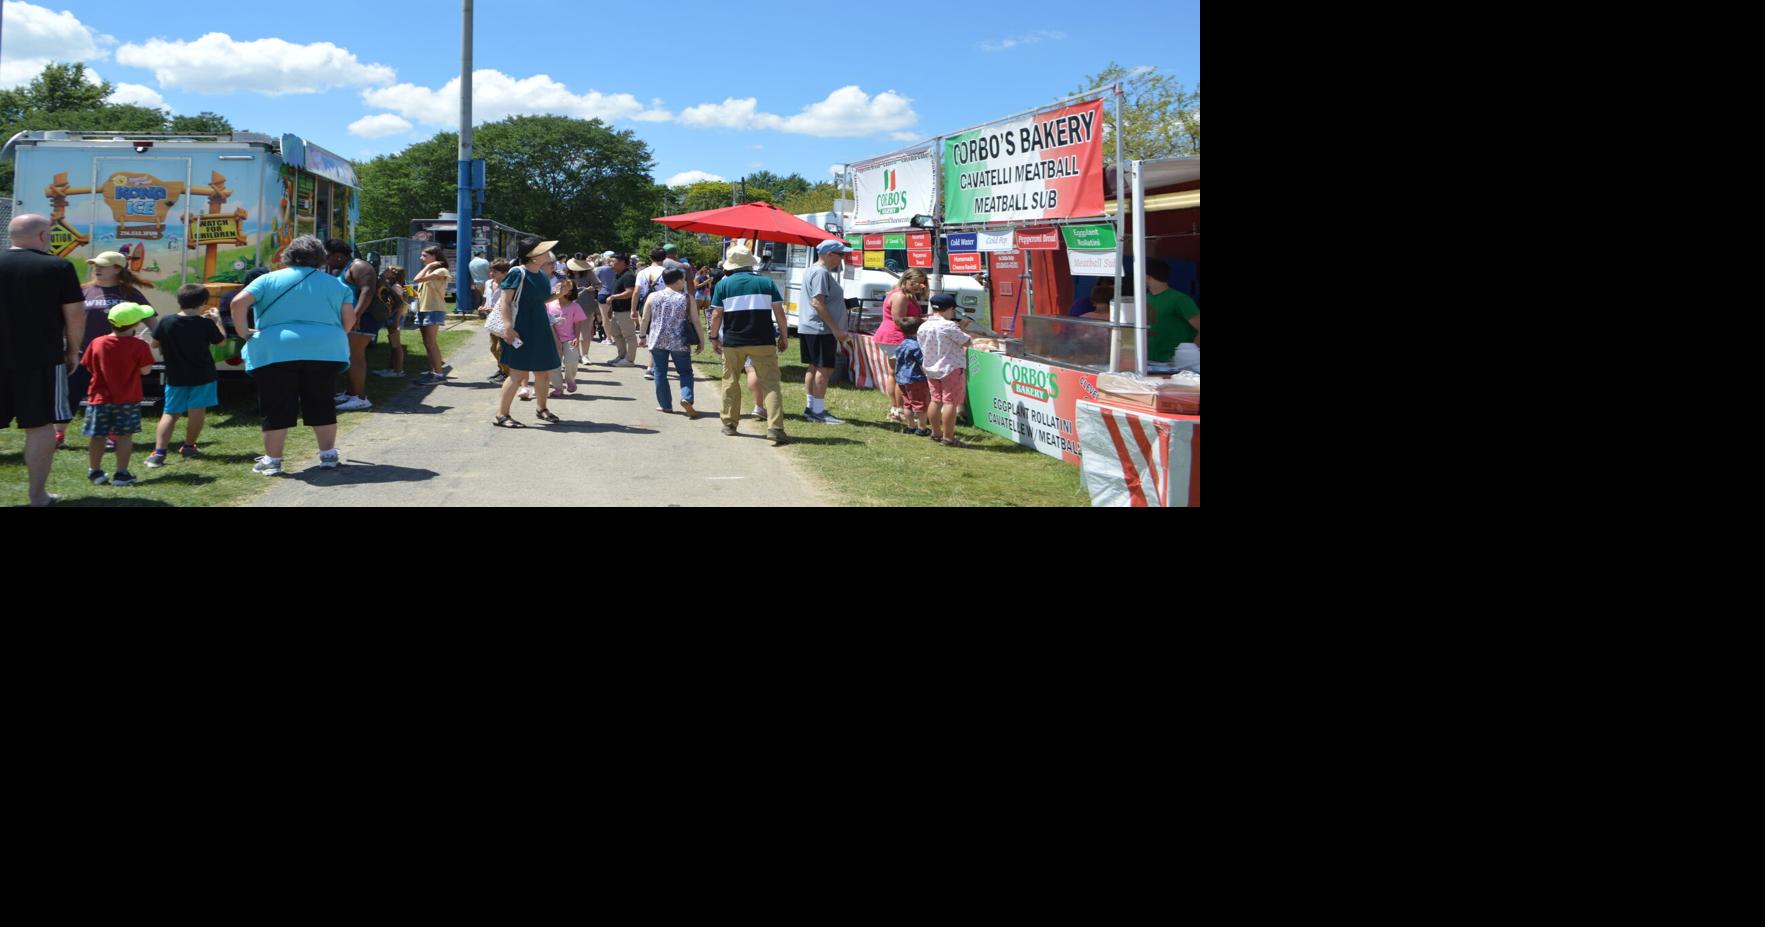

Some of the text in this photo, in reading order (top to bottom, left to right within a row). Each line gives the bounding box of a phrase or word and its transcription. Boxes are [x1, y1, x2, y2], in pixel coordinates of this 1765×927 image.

[953, 110, 1095, 166] CORBO'S BAKERY
[960, 166, 1012, 190] CAVATELLI
[1014, 155, 1079, 182] MEATBALL
[115, 186, 167, 201] KONA
[974, 189, 1057, 214] MEATBALL SUB
[126, 199, 155, 215] ICE
[199, 219, 229, 227] WATCH
[194, 231, 236, 239] CHILDREN
[1002, 361, 1059, 399] CORBO'S
[1016, 384, 1043, 398] BAKERY
[993, 397, 1072, 434] EGGPLANT ROLLATINI
